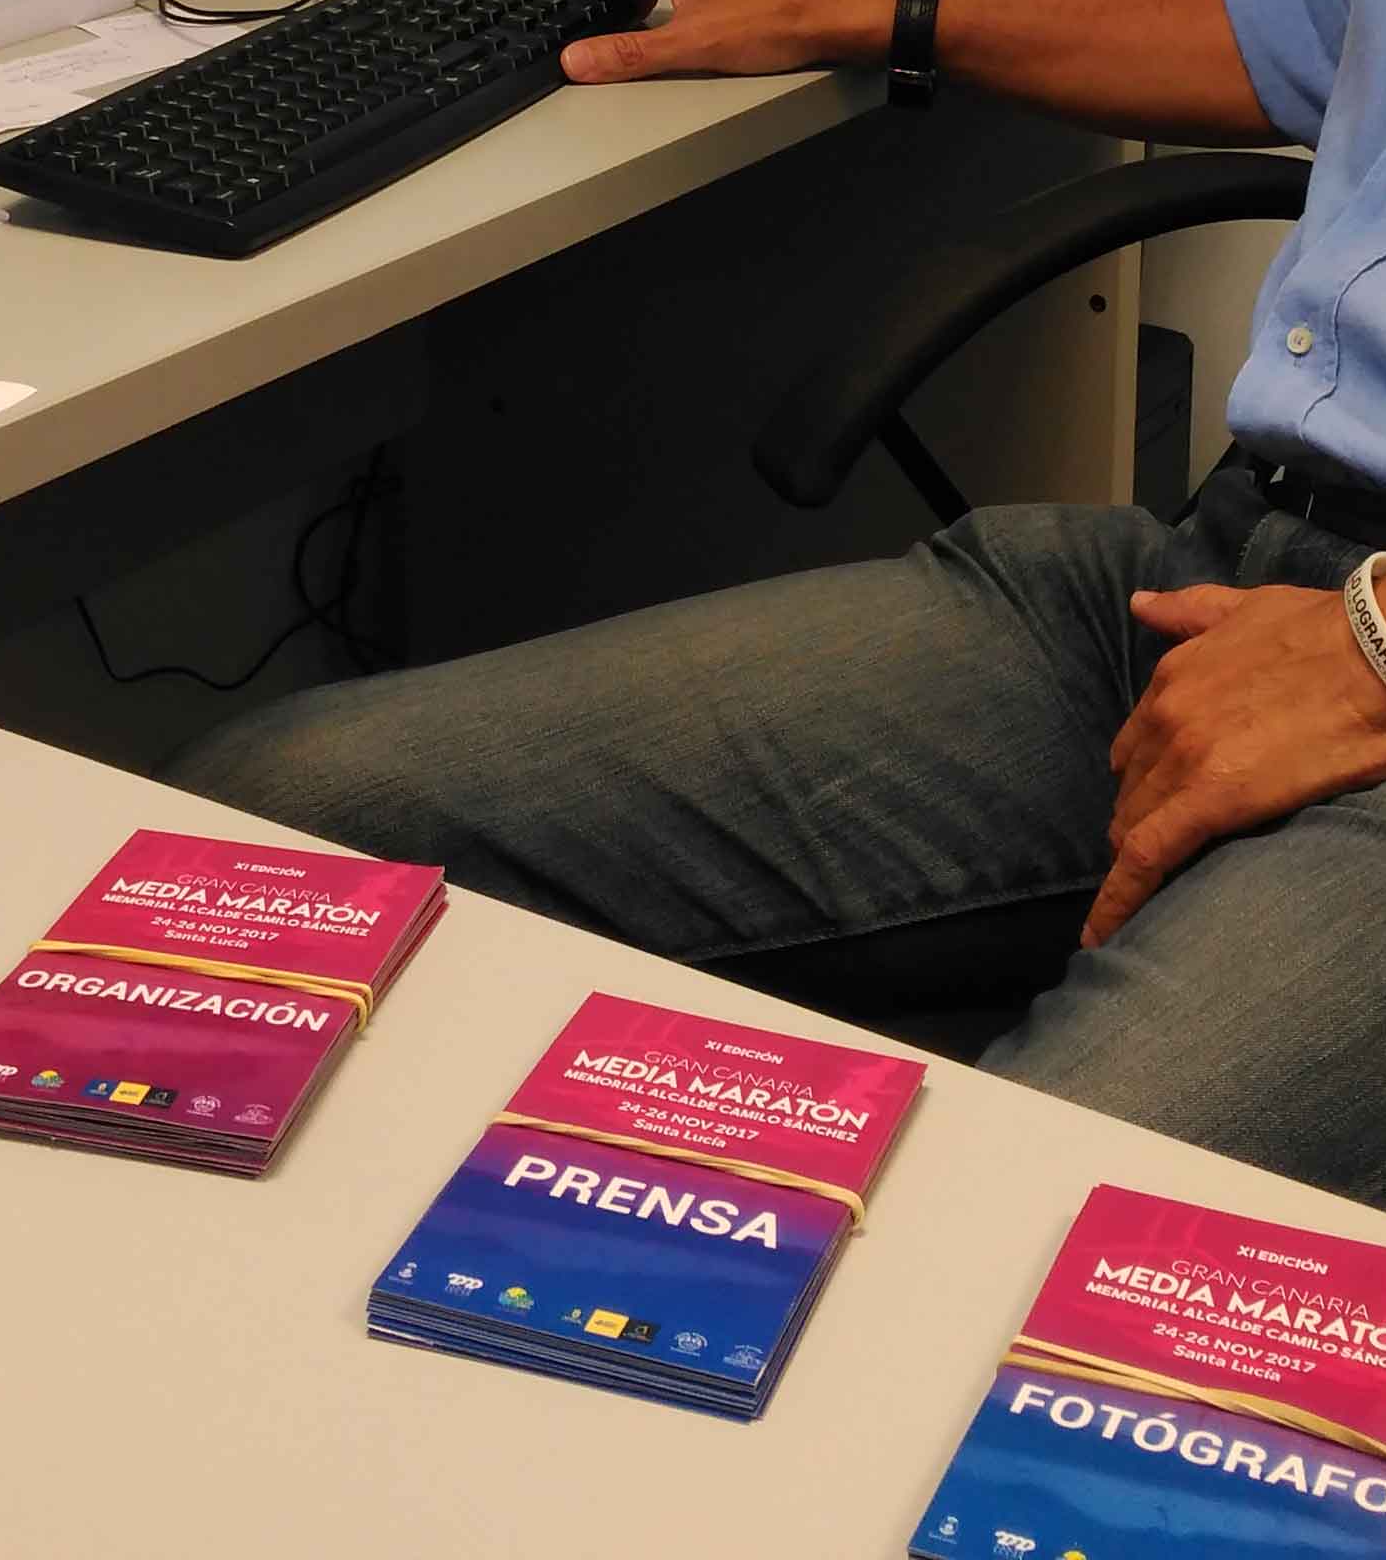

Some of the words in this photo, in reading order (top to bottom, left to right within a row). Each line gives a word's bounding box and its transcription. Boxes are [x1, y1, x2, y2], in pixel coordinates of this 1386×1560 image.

[177, 874, 236, 890] GRAN
[239, 883, 331, 902] CANARIA
[234, 862, 248, 871] XI
[250, 864, 306, 878] EDICIÓN
[102, 894, 175, 910] MEMORIAL
[179, 902, 242, 919] ALCALDE
[244, 912, 299, 927] CAMILO
[301, 918, 371, 936] SÁNCHEZ
[111, 878, 207, 903] MEDIA
[217, 892, 380, 926] MARATÓN
[151, 916, 195, 930] 24-26
[200, 923, 238, 936] NOV
[239, 928, 279, 941] 2017
[164, 929, 206, 943] Santa
[210, 935, 249, 949] Lucía
[16, 968, 330, 1033] ORGANIZACIÓN
[645, 1051, 709, 1074] GRAN
[713, 1067, 813, 1098] CANARIA
[705, 1040, 721, 1051] XI
[723, 1045, 783, 1065] EDICIÓN
[564, 1069, 645, 1094] MEMORIAL
[648, 1087, 717, 1111] ALCALDE
[719, 1105, 781, 1124] CAMILO
[783, 1116, 859, 1143] SÁNCHEZ
[573, 1050, 678, 1088] MEDIA
[688, 1076, 869, 1130] MARATÓN
[618, 1101, 667, 1119] 24-26
[671, 1113, 713, 1131] NOV
[715, 1123, 759, 1140] 2017
[632, 1118, 679, 1137] Santa
[683, 1129, 726, 1149] Lucía
[503, 1153, 779, 1250] PRENSA
[1093, 1257, 1214, 1307] MEDIA
[1237, 1245, 1256, 1259] XI
[1258, 1250, 1328, 1275] EDICIÓN
[1172, 1260, 1246, 1288] GRAN
[1252, 1280, 1369, 1320] CANARIA
[1085, 1281, 1179, 1315] MEMORIAL
[1183, 1306, 1262, 1336] ALCALDE
[1266, 1327, 1337, 1354] CAMILO
[1153, 1323, 1210, 1347] 24-26
[1215, 1339, 1264, 1360] NOV
[1265, 1351, 1316, 1373] 2017
[1173, 1344, 1227, 1368] Santa
[1230, 1361, 1281, 1382] Lucía
